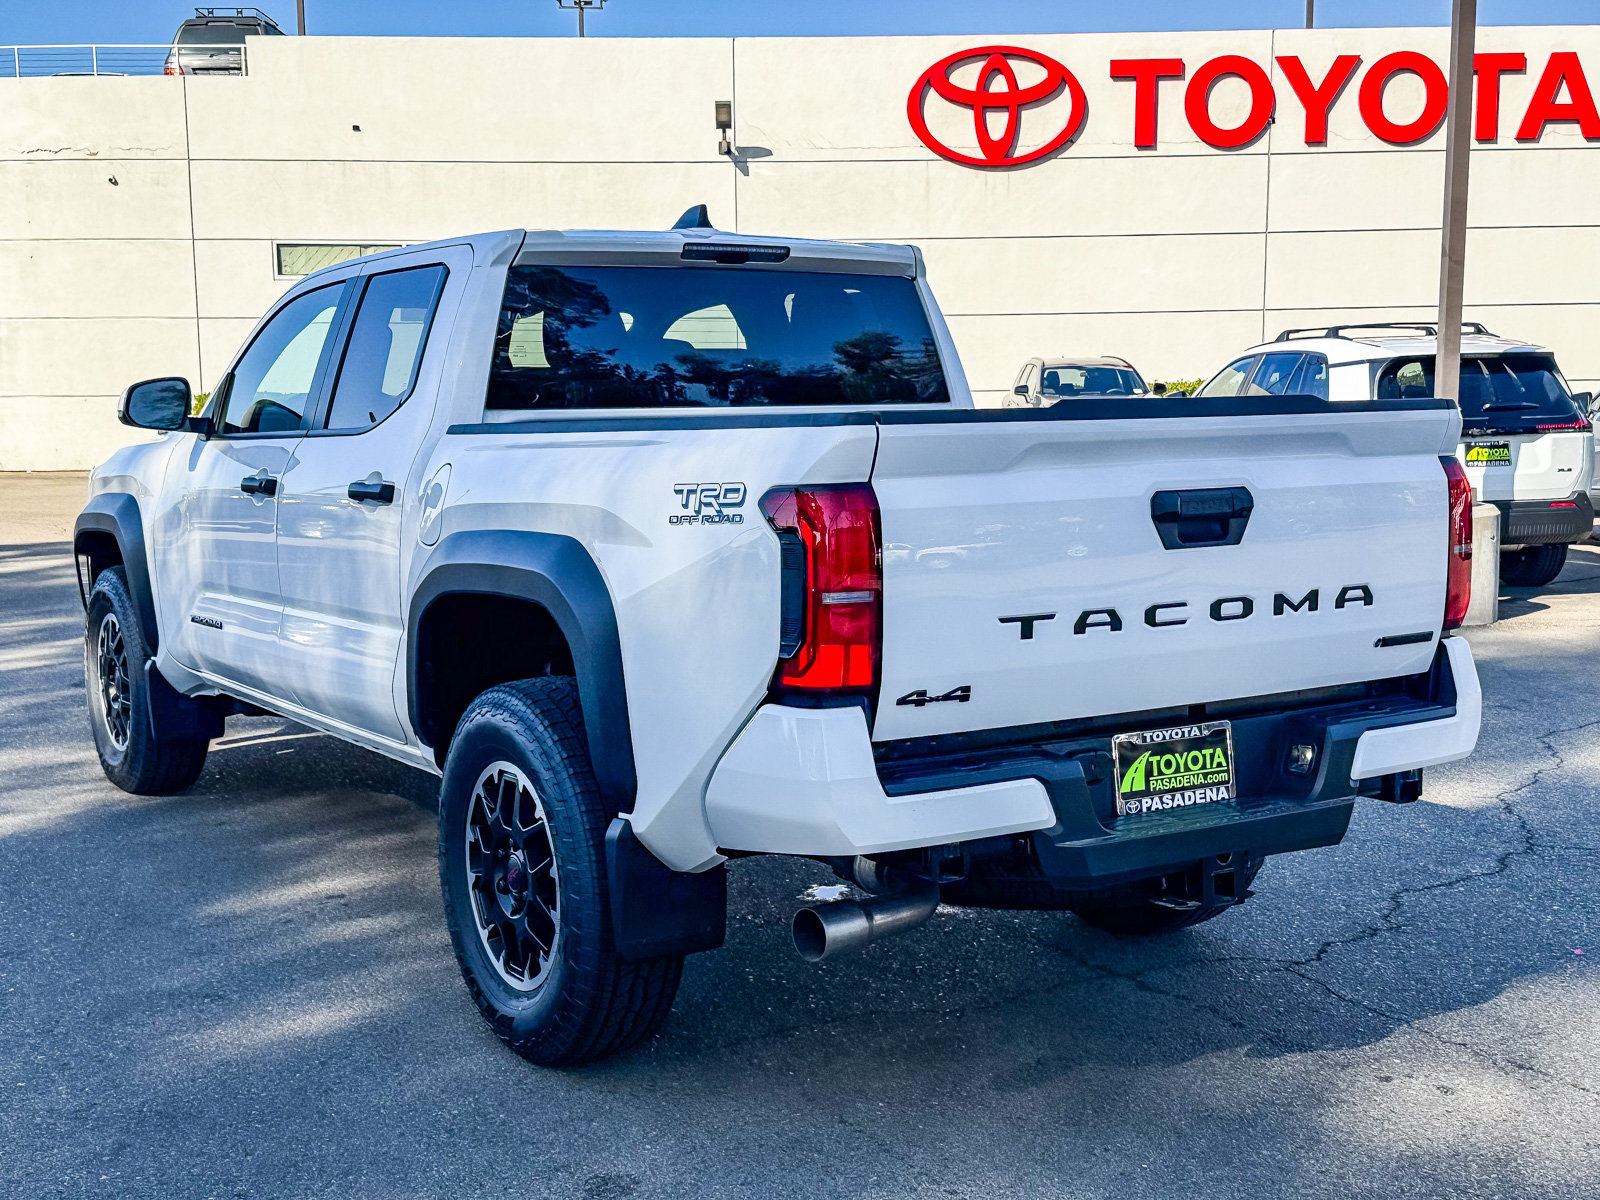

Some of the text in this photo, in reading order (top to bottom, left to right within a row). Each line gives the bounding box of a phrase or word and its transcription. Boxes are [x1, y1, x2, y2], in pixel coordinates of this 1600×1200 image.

[1110, 51, 1600, 151] TOYOTA
[1478, 448, 1509, 456] TOYOTA
[674, 482, 747, 515] TRD
[669, 513, 744, 525] OFF ROAD
[998, 583, 1374, 640] TACOMA
[1144, 727, 1200, 742] TOYOTA
[1149, 748, 1227, 776] TOYOTA
[1150, 773, 1228, 792] PASADENA.com
[1142, 786, 1229, 813] PASADENA
